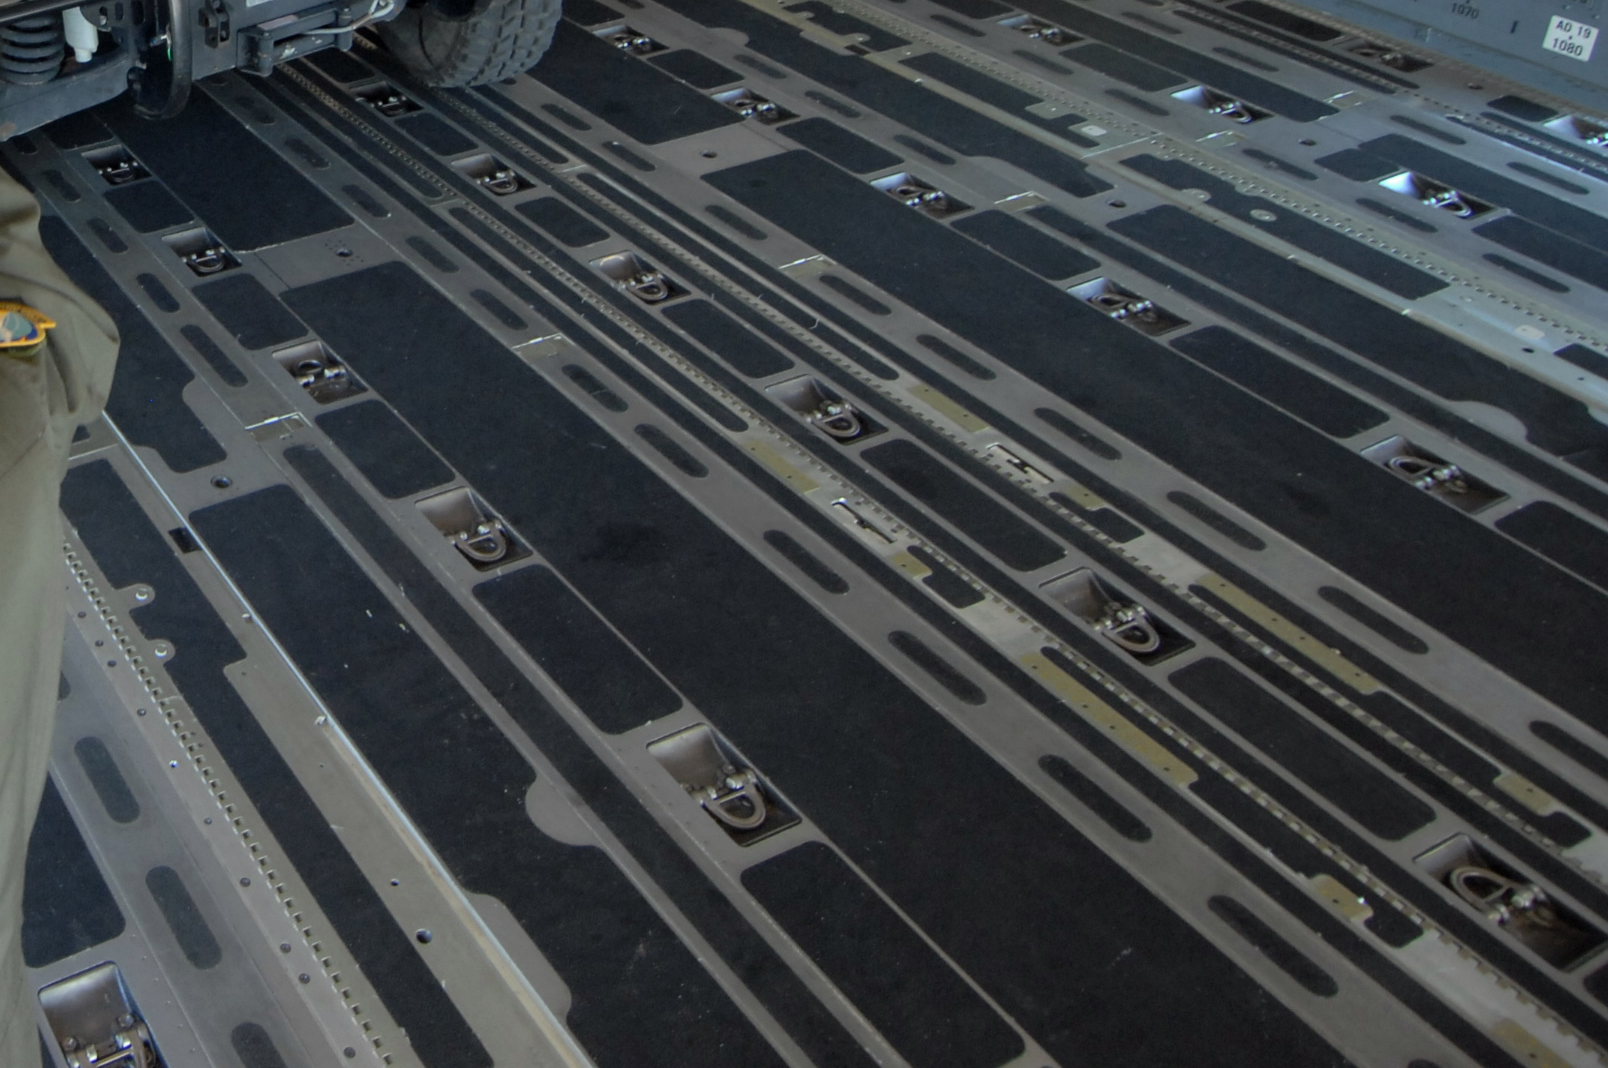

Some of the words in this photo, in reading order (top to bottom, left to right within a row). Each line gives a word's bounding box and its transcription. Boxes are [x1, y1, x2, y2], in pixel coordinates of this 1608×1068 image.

[1451, 2, 1479, 20] 1070
[1555, 19, 1573, 33] AD
[1577, 25, 1592, 39] 19
[1552, 37, 1584, 56] 1080
